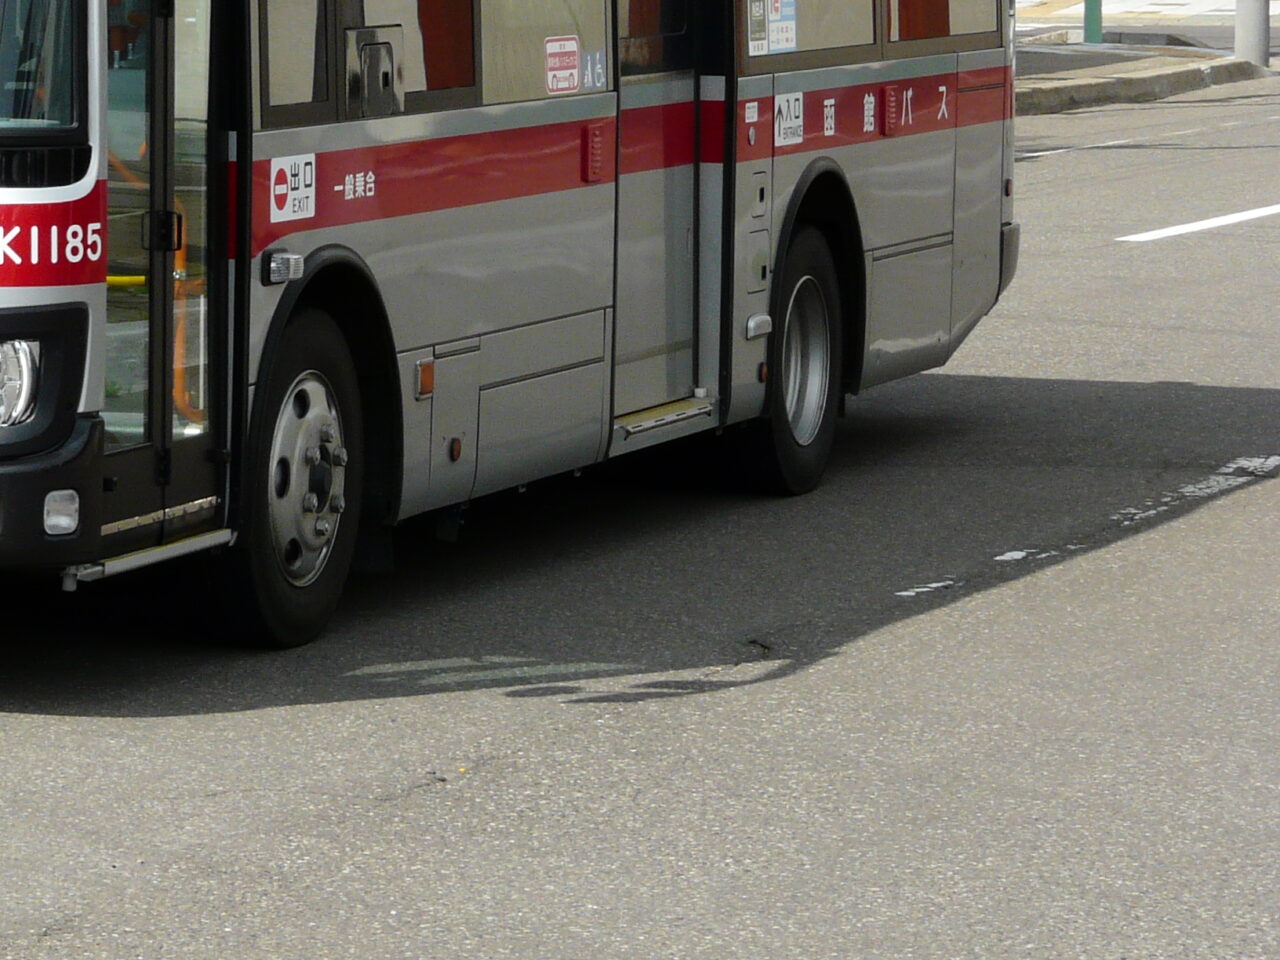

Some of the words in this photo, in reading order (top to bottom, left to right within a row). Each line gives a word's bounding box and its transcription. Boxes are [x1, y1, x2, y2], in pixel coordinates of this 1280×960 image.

[785, 98, 800, 121] 入口
[290, 161, 313, 191] 出口
[334, 171, 376, 200] 一般乗合
[292, 196, 310, 213] EXIT
